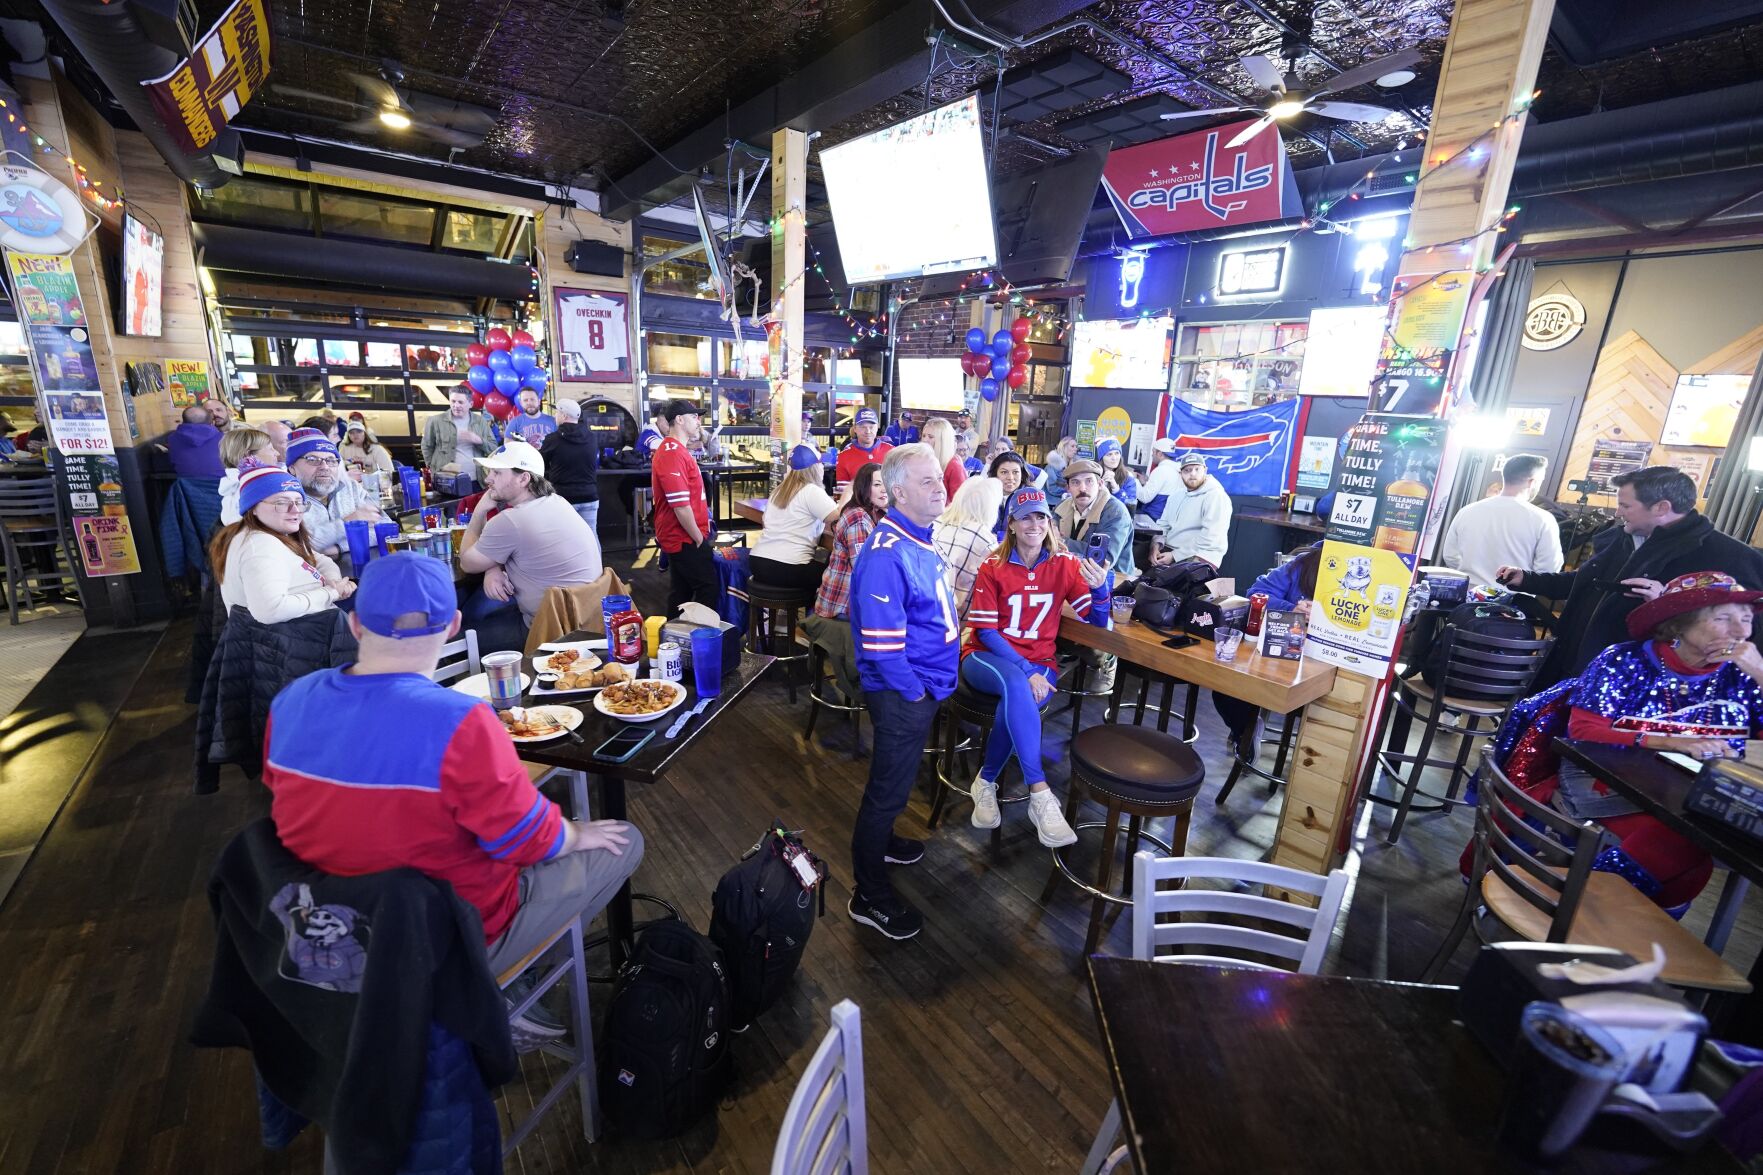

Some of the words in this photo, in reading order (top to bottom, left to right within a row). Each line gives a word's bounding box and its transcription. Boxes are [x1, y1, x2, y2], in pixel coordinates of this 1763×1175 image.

[169, 66, 216, 148] COMMANDERS
[1143, 173, 1201, 188] WASHINGTON
[18, 256, 62, 274] NEW!
[576, 308, 612, 318] OVECHKIN
[588, 320, 605, 350] 8
[172, 362, 201, 373] NEW!
[1378, 379, 1410, 411] $7
[61, 439, 82, 448] FOR
[86, 438, 108, 448] $12!
[664, 442, 678, 451] 17
[1350, 438, 1383, 454] TIME,
[66, 466, 88, 474] TIME,
[1344, 455, 1383, 471] TULLY
[69, 482, 92, 490] TIME!
[1340, 472, 1376, 488] TIME!
[1346, 499, 1362, 514] $7
[1387, 495, 1424, 506] TULLAMORE
[1334, 512, 1350, 522] ALL
[1350, 515, 1368, 525] DAY
[97, 525, 118, 533] PINK
[871, 531, 901, 550] 17
[1330, 597, 1370, 613] LUCKY
[1002, 592, 1054, 640] 17
[1331, 614, 1362, 627] LEMONADE
[1335, 608, 1360, 620] ONE
[1310, 624, 1323, 632] REAL
[1344, 633, 1360, 642] REAL
[1321, 648, 1338, 658] $8.00
